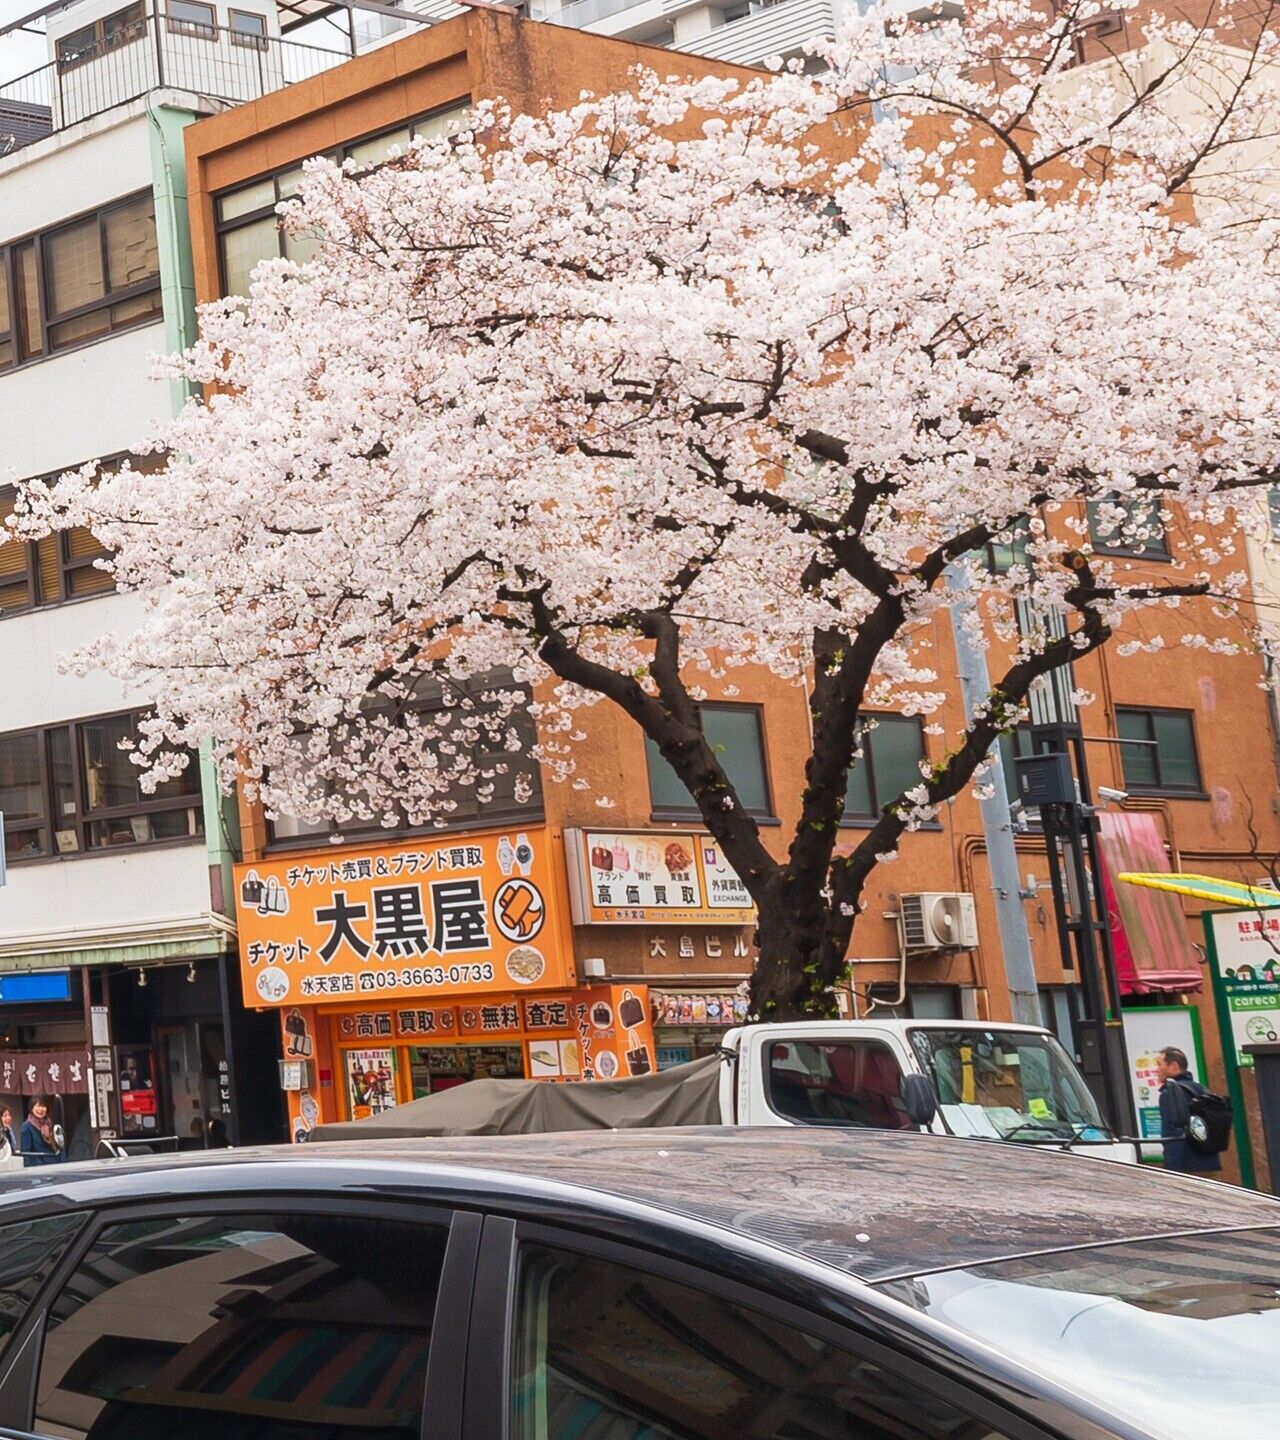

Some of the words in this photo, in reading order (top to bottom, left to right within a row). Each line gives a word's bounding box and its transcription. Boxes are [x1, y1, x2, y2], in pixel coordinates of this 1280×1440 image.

[597, 884, 697, 905] 高価買取
[713, 894, 749, 903] EXCHANGE
[316, 878, 490, 964] 大黒屋
[248, 938, 310, 965] チケット
[650, 934, 750, 959] 大島ビル
[302, 976, 355, 995] 水天宮店
[376, 964, 494, 989] 03-3663-0733
[1234, 996, 1277, 1007] careco
[356, 1012, 393, 1037] 高価
[398, 1009, 437, 1034] 買取
[480, 1004, 520, 1029] 無料
[527, 1002, 568, 1027] 査定
